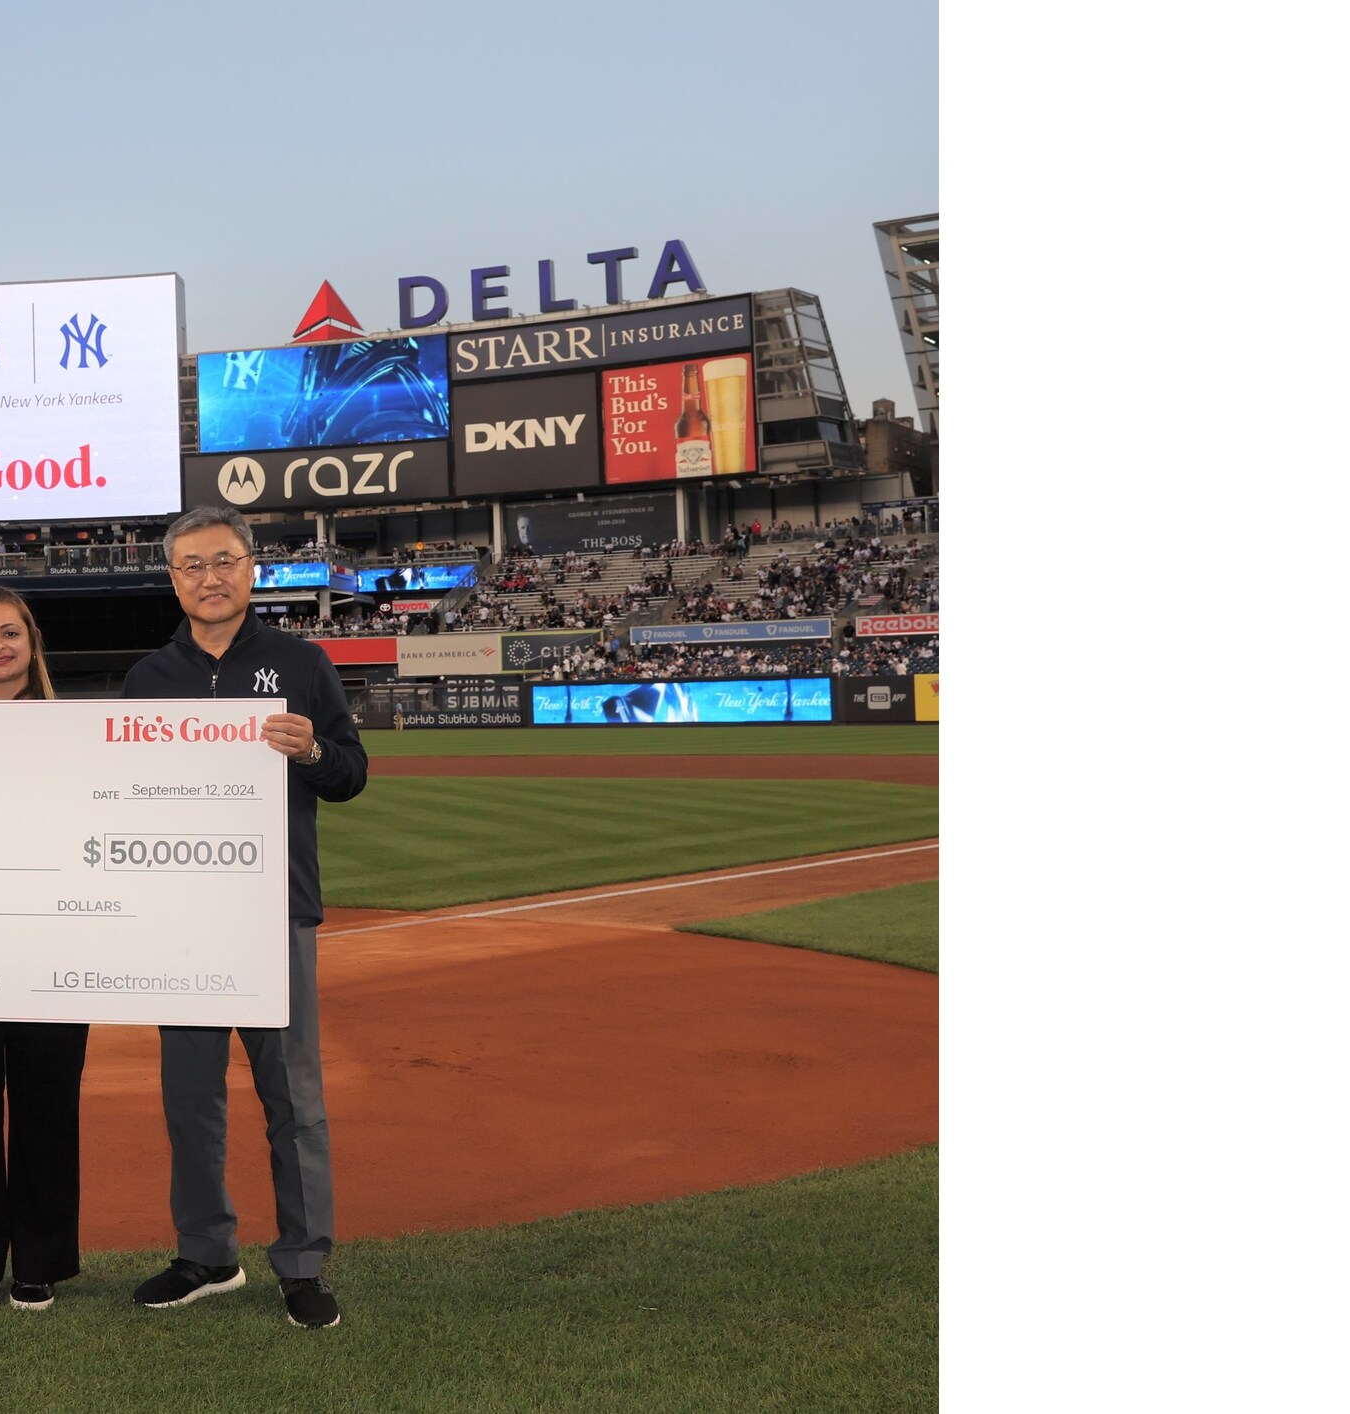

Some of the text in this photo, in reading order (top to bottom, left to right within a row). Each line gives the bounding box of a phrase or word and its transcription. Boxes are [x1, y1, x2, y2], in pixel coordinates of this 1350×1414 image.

[398, 240, 705, 328] DELTA
[455, 314, 744, 374] STARR INSURANCE
[609, 374, 657, 394] This
[0, 395, 31, 408] New
[34, 394, 65, 407] York
[69, 392, 123, 406] Yankees
[611, 393, 668, 415] Bud's
[465, 413, 586, 453] DKNY
[611, 417, 647, 435] For
[611, 438, 657, 456] You.
[284, 450, 414, 498] razr
[581, 535, 642, 548] THE BOSS
[393, 603, 429, 611] TOYOTA
[653, 630, 687, 638] FANDUEL
[715, 628, 749, 637] FANDUEL
[858, 616, 939, 634] Reebok
[541, 646, 590, 658] CLEA
[716, 693, 779, 714] New York
[892, 694, 906, 702] APP
[438, 713, 478, 724] StubHub
[481, 713, 521, 723] StubHub
[105, 716, 174, 742] Life's
[93, 784, 254, 800] DATE September 12, 2024
[83, 836, 257, 868] $ 50,000.00
[57, 900, 121, 912] DOLLARS
[53, 971, 237, 991] LG Electronics USA
